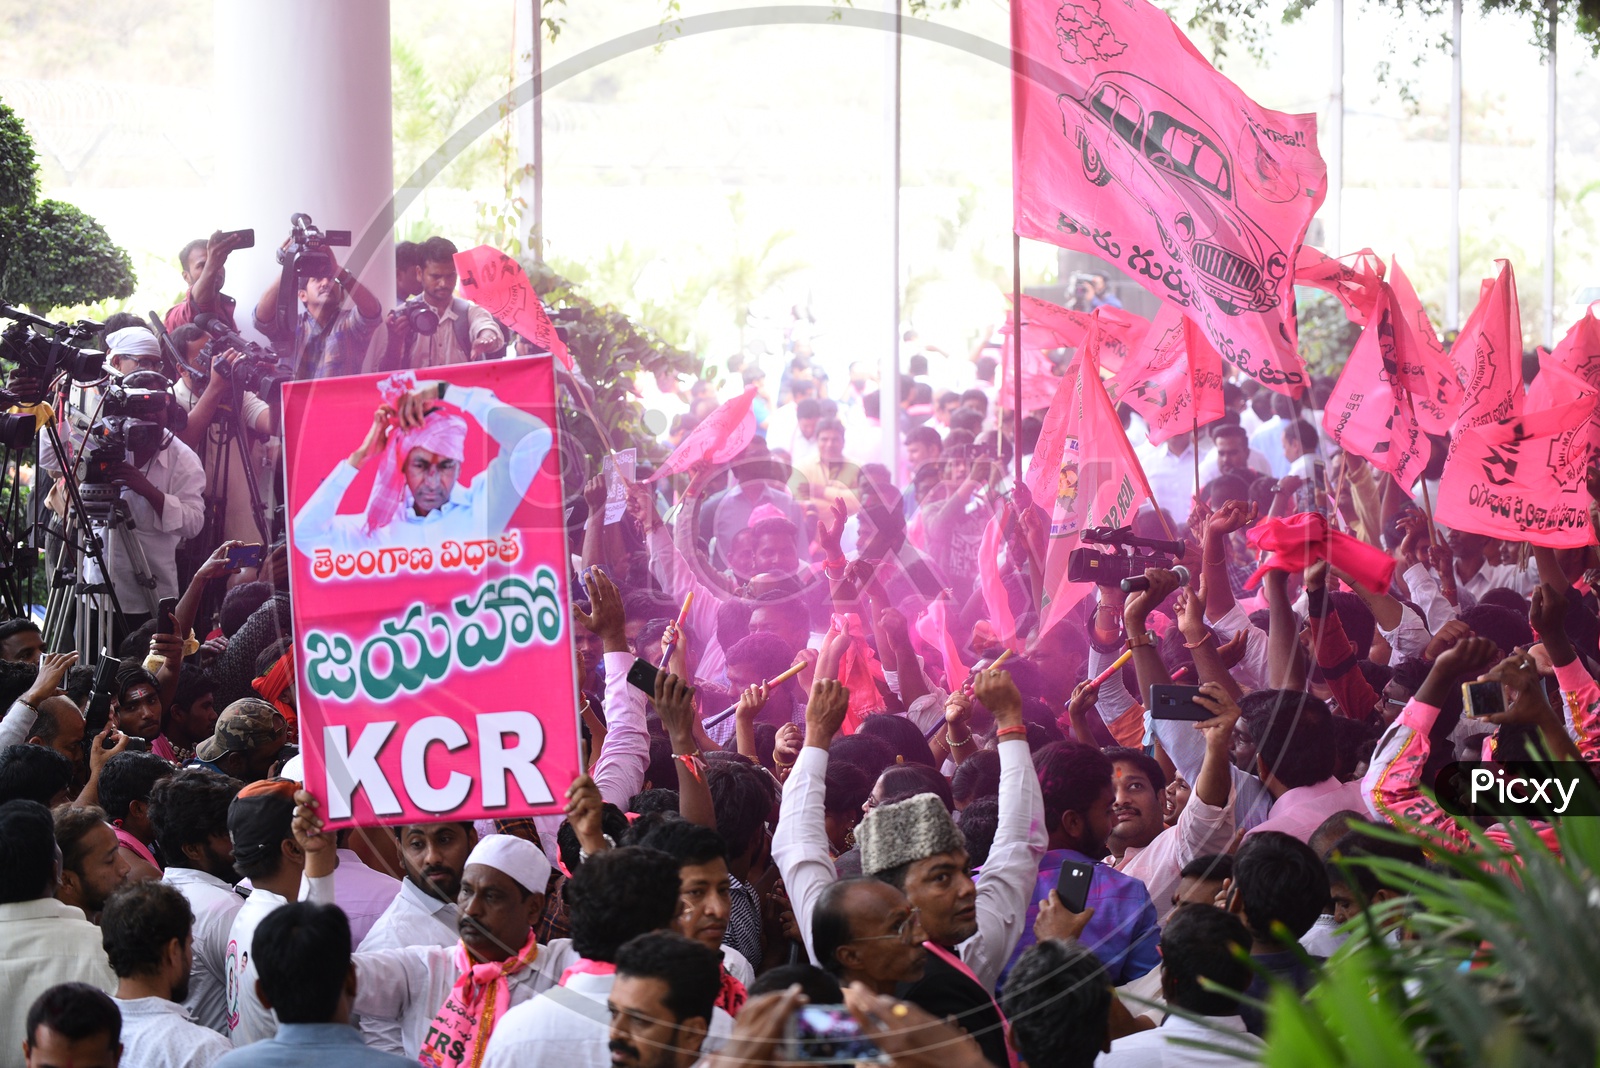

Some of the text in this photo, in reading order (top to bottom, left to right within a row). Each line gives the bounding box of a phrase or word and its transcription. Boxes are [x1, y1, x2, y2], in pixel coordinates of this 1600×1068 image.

[1204, 284, 1224, 298] TRS
[313, 532, 520, 579] తెలంగాణ విధాత
[306, 568, 560, 700] జయహో
[322, 710, 556, 820] KCR
[1403, 798, 1438, 822] RS
[424, 1026, 465, 1063] TRS
